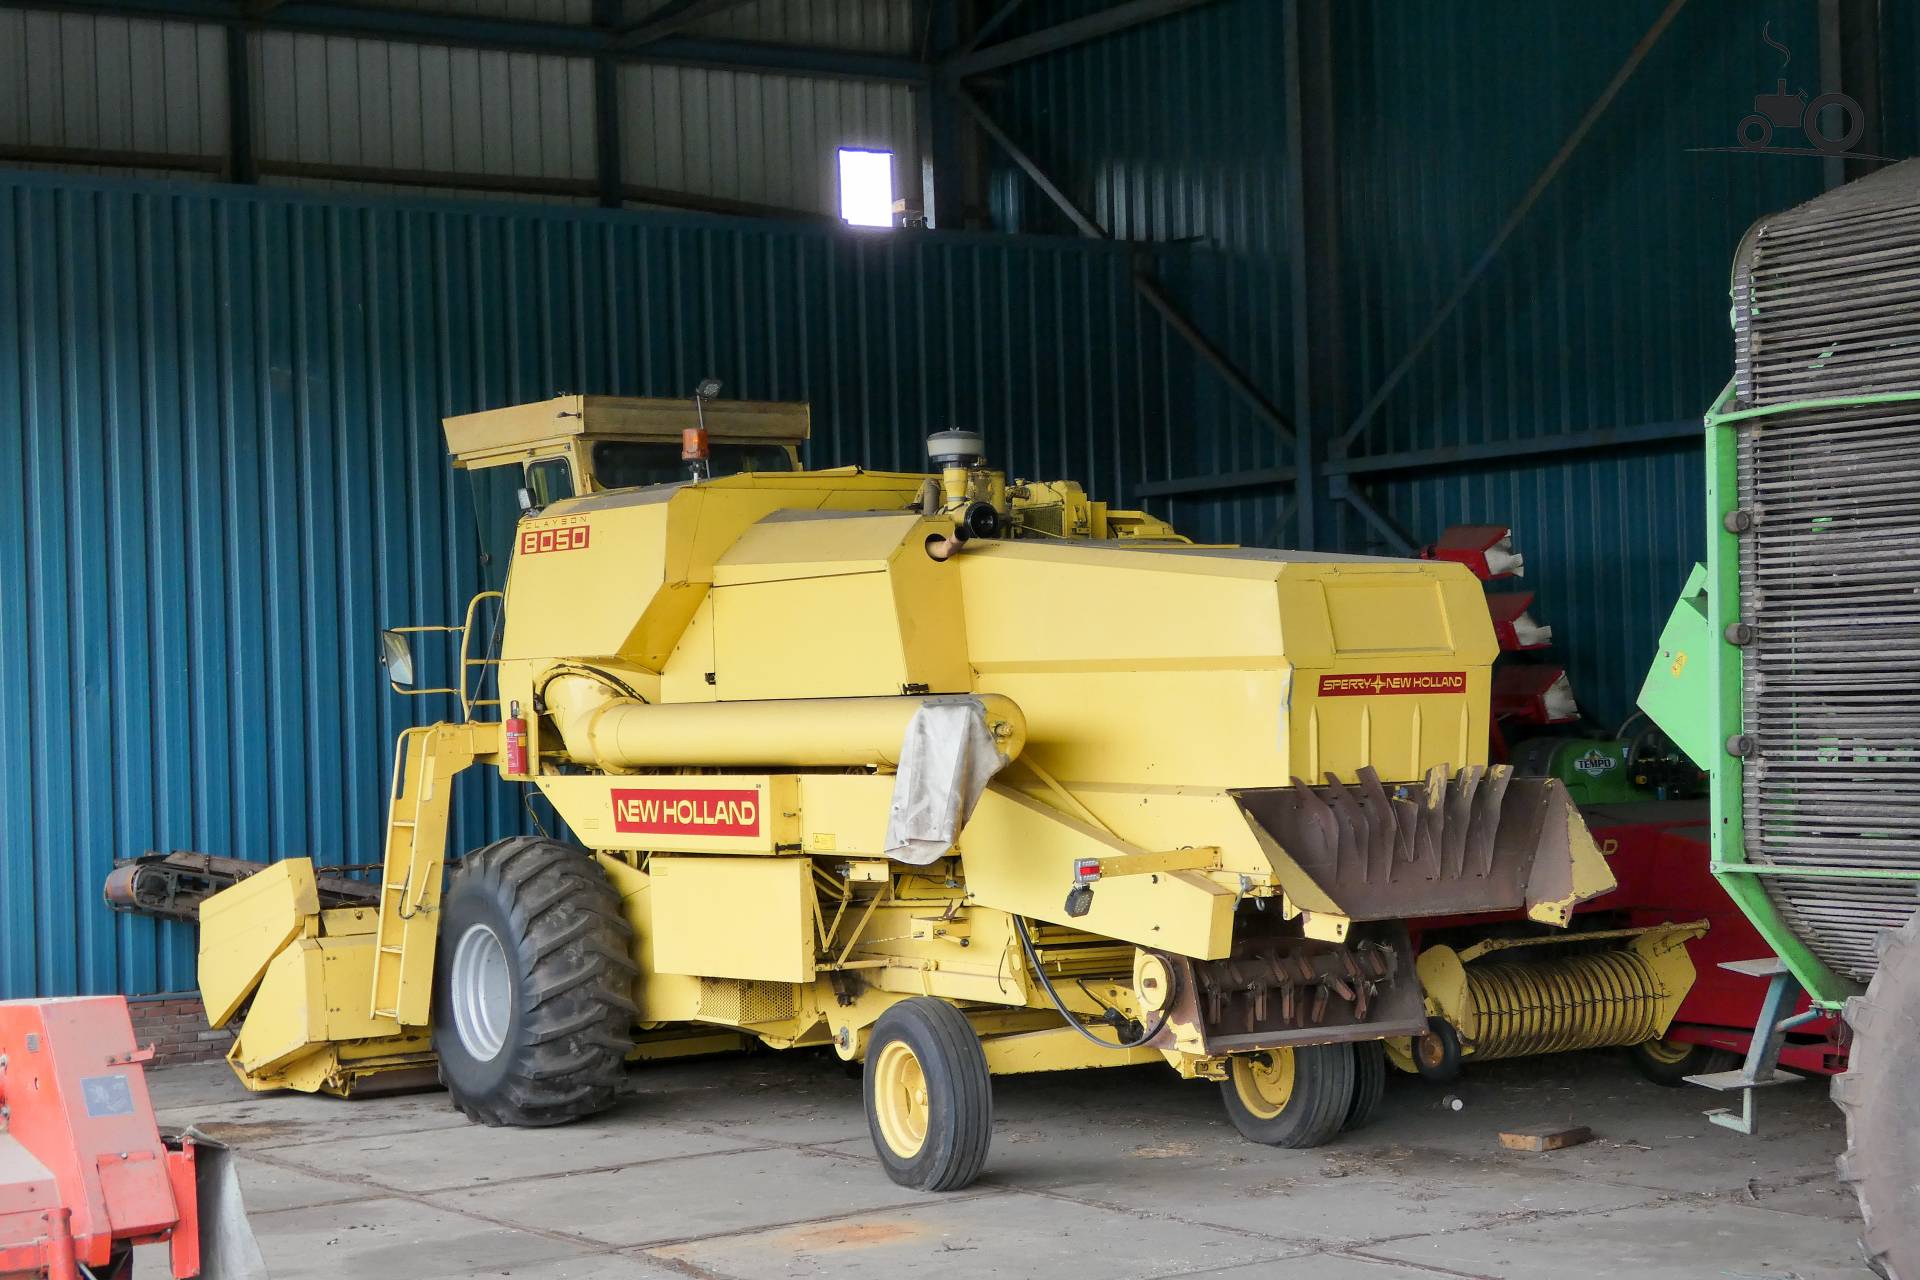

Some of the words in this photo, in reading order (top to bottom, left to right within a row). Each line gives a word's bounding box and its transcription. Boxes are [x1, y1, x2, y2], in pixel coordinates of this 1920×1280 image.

[525, 515, 587, 530] CLAYSON
[524, 527, 587, 553] 8050
[1322, 678, 1372, 691] SPERRY
[1386, 677, 1412, 689] NEW
[1413, 676, 1463, 688] HOLLAND
[1578, 758, 1611, 769] TEMPO
[617, 799, 660, 823] NEW
[663, 800, 756, 826] HOLLAND
